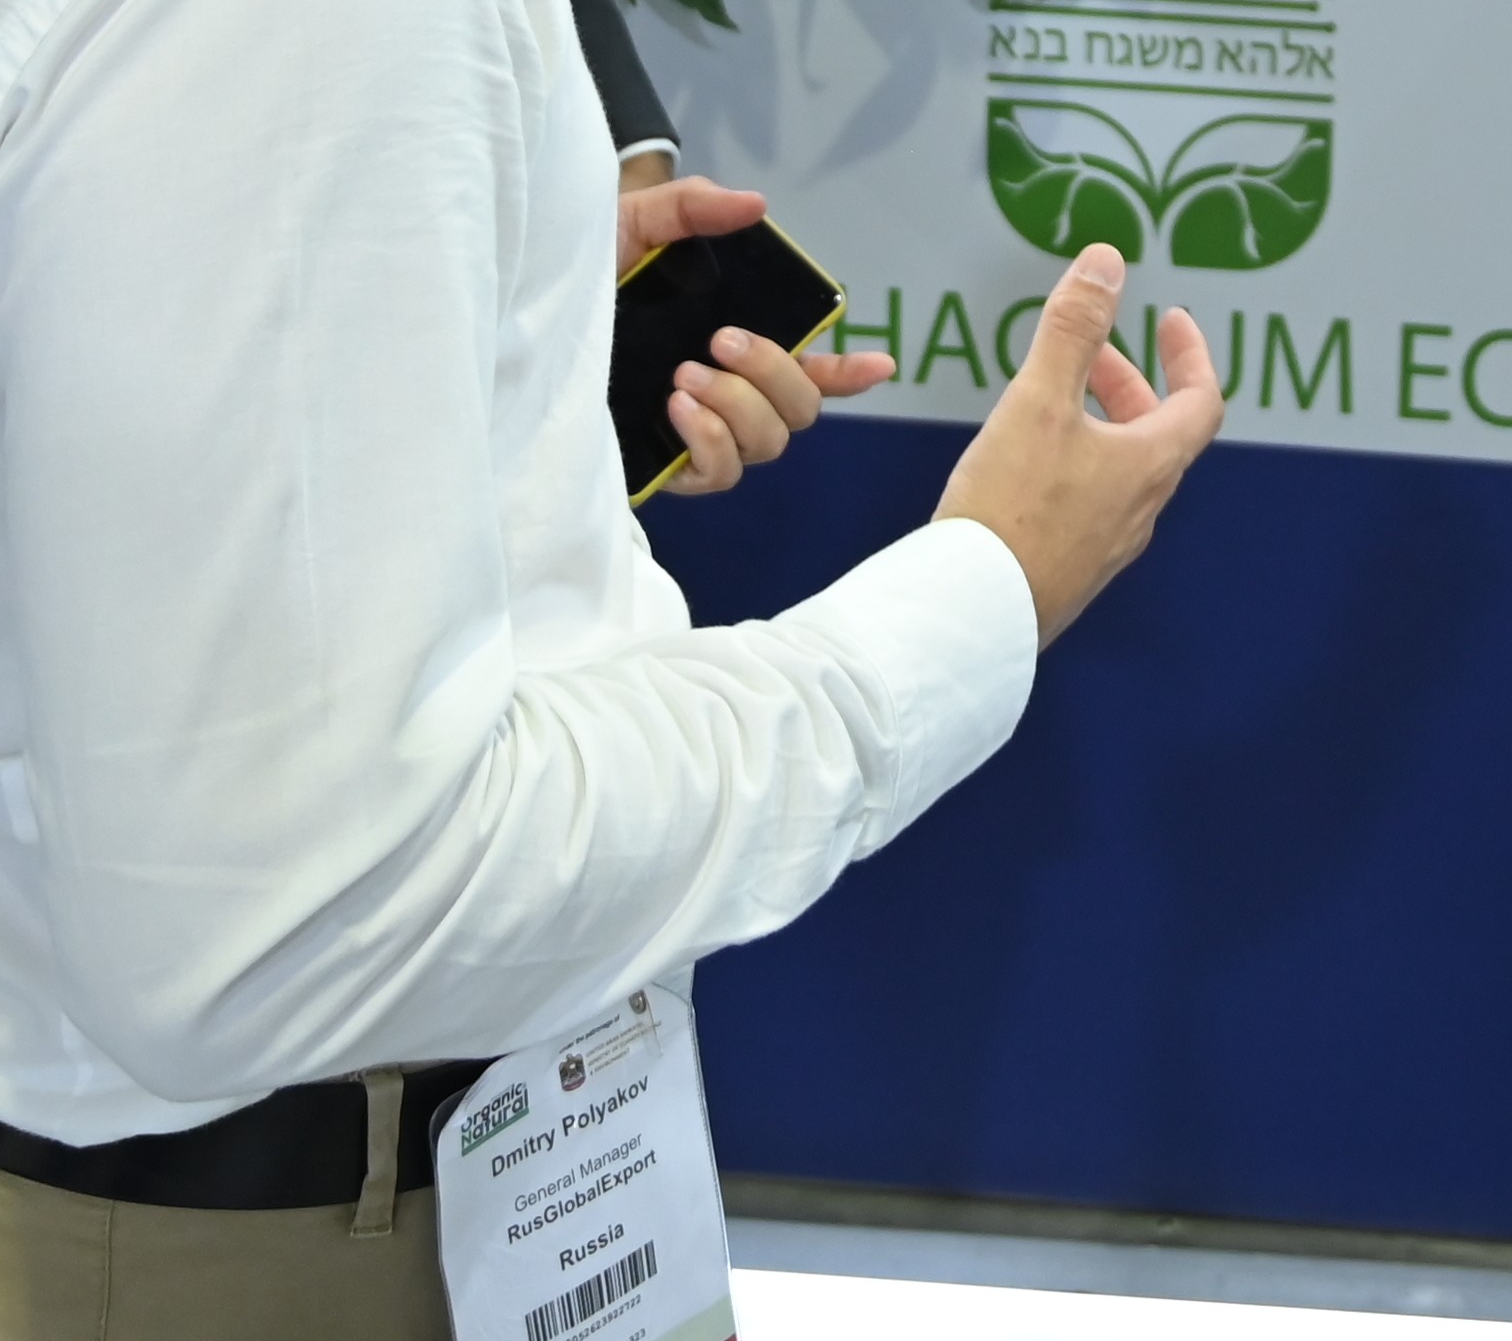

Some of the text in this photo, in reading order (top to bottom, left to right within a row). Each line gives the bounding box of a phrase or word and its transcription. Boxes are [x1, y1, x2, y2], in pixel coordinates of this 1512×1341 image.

[988, 24, 1068, 63] בנא
[1214, 27, 1335, 80] אלהא
[461, 1082, 524, 1133] Organic
[461, 1088, 529, 1151] Natural
[490, 1075, 650, 1178] Dmitry Polyakov
[507, 1149, 657, 1245] RusGlobalExport
[514, 1133, 643, 1213] General Manager
[558, 1222, 626, 1272] Russia
